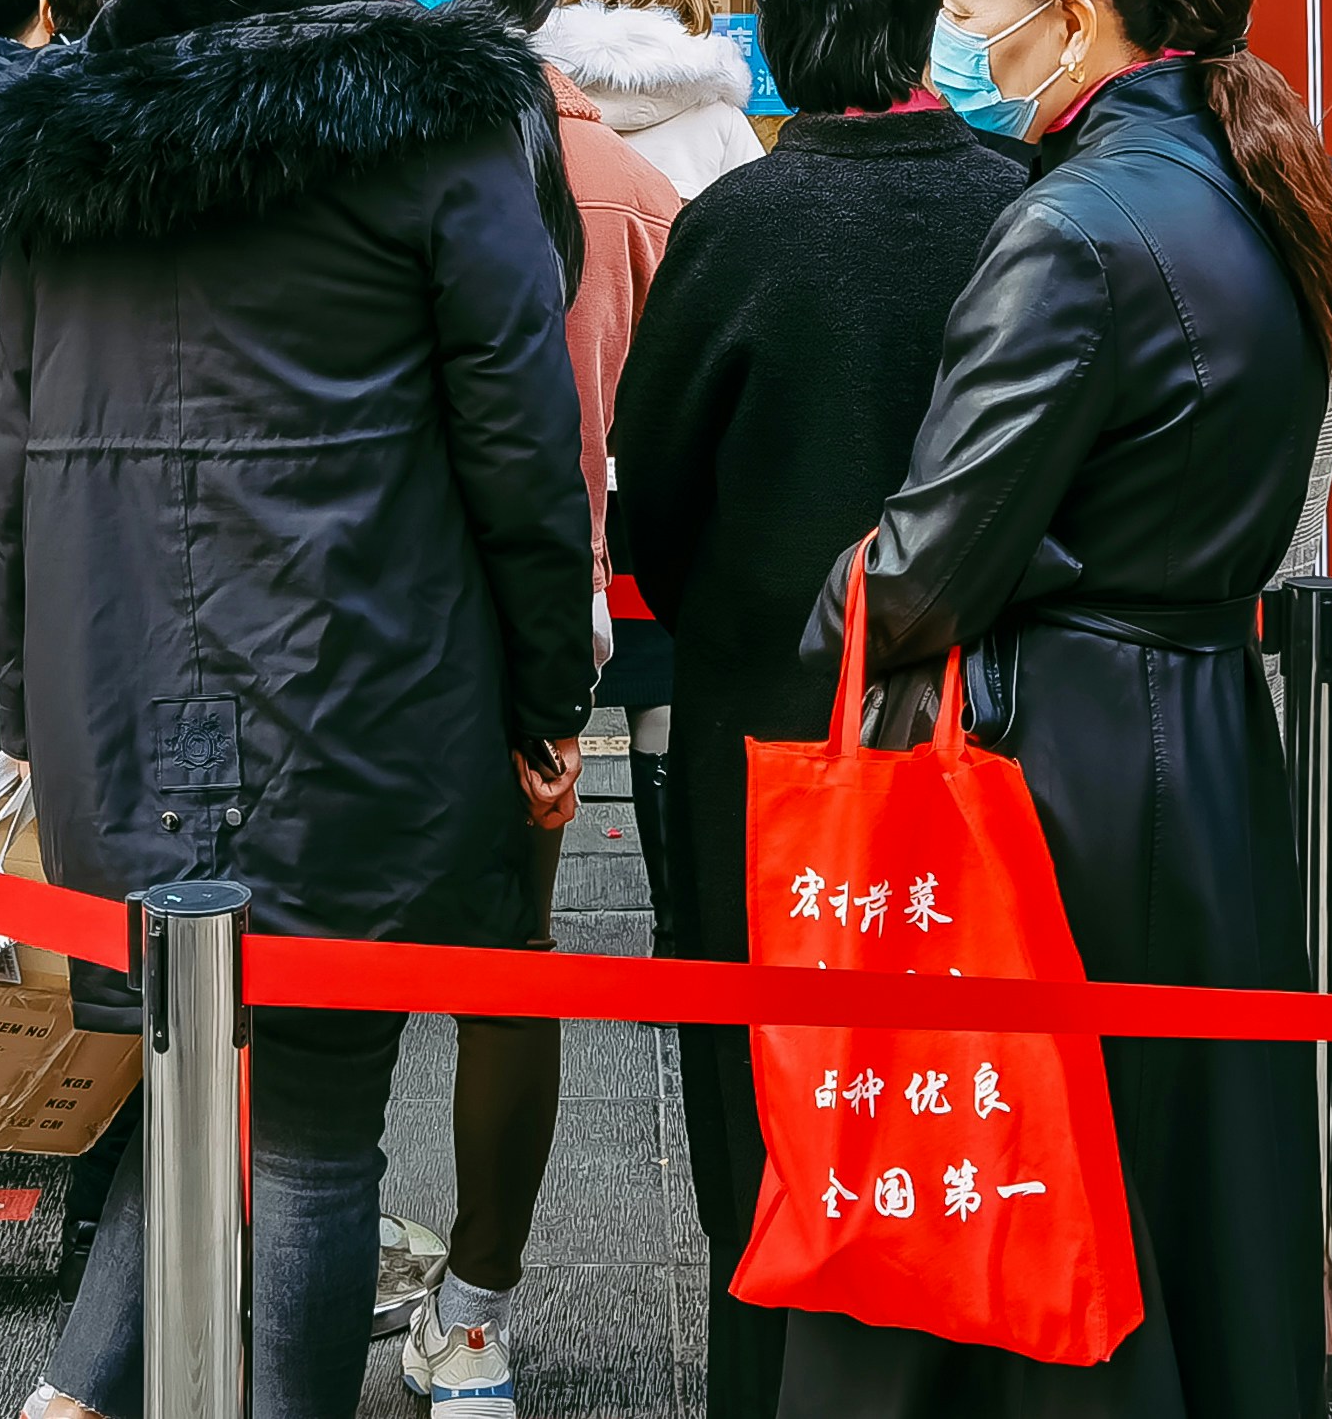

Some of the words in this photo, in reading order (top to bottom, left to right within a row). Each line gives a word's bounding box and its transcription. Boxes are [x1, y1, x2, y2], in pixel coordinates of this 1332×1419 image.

[44, 1097, 77, 1111] KGS
[39, 1119, 64, 1130] CM
[821, 1158, 1047, 1223] 全国第一
